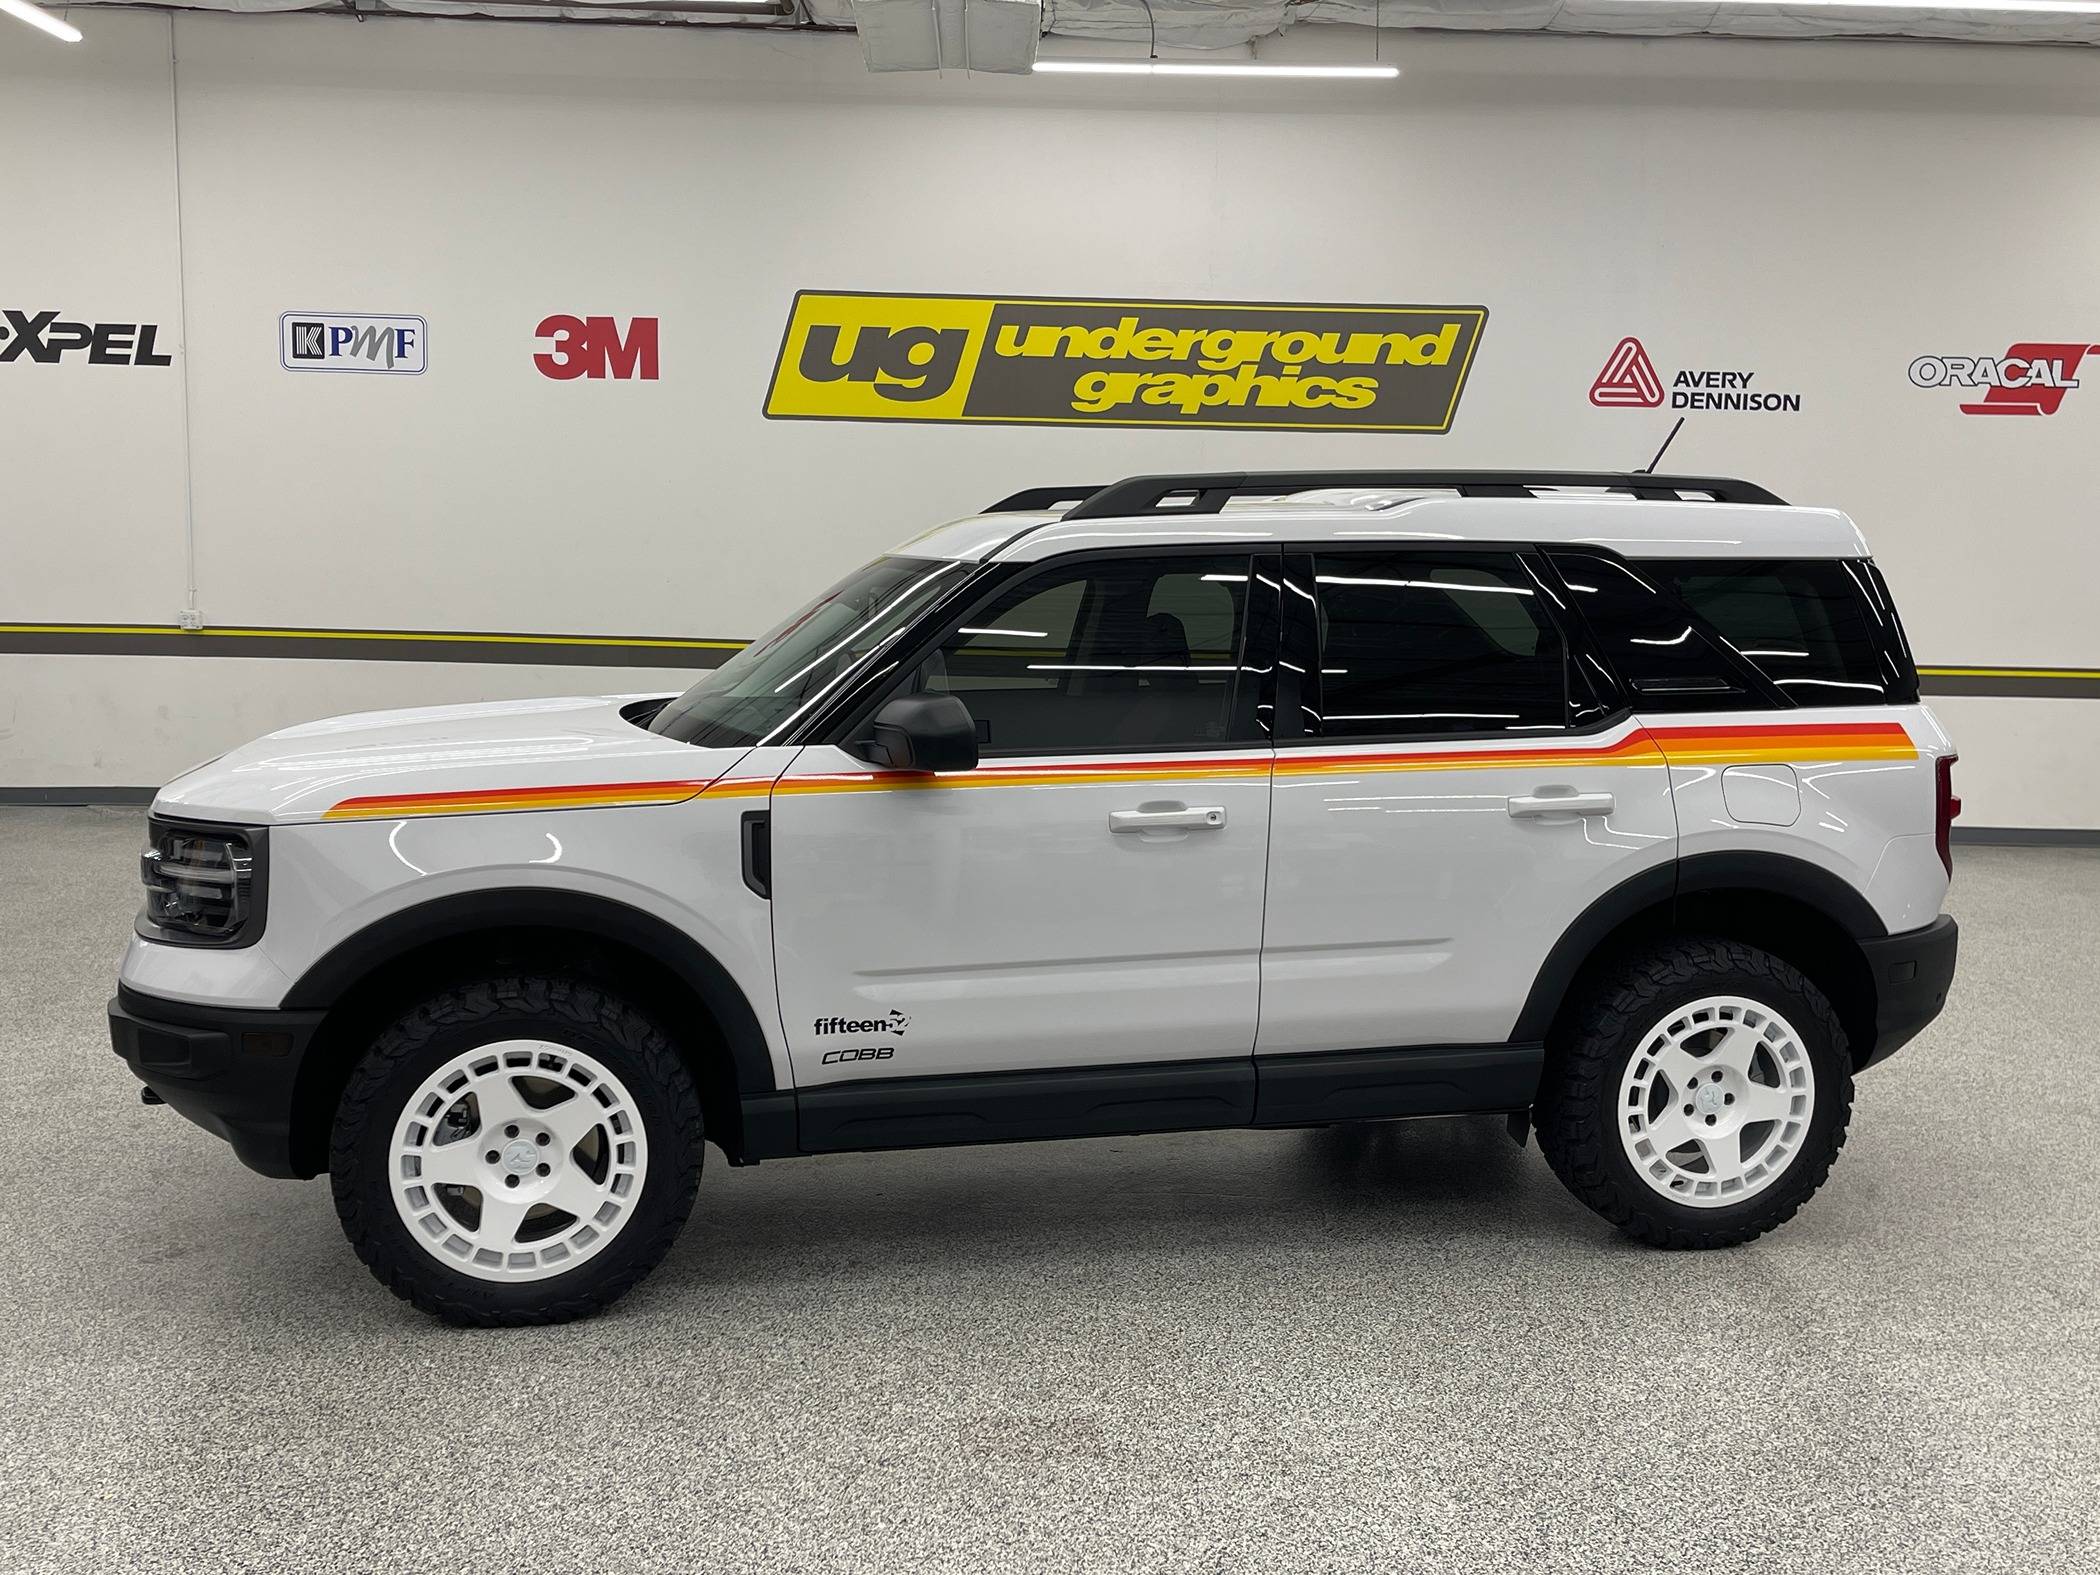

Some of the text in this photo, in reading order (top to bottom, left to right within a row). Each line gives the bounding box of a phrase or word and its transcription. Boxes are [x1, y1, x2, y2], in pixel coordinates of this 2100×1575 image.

[0, 310, 172, 366] XPEL
[293, 322, 416, 369] KPMF
[533, 314, 659, 380] 3M
[798, 324, 969, 401] ug
[995, 317, 1463, 370] underground
[1071, 363, 1379, 414] graphics
[1673, 371, 1754, 389] AVERY
[1908, 356, 2079, 388] ORACAL
[1671, 391, 1800, 412] DENNISON
[822, 1047, 894, 1065] COBB
